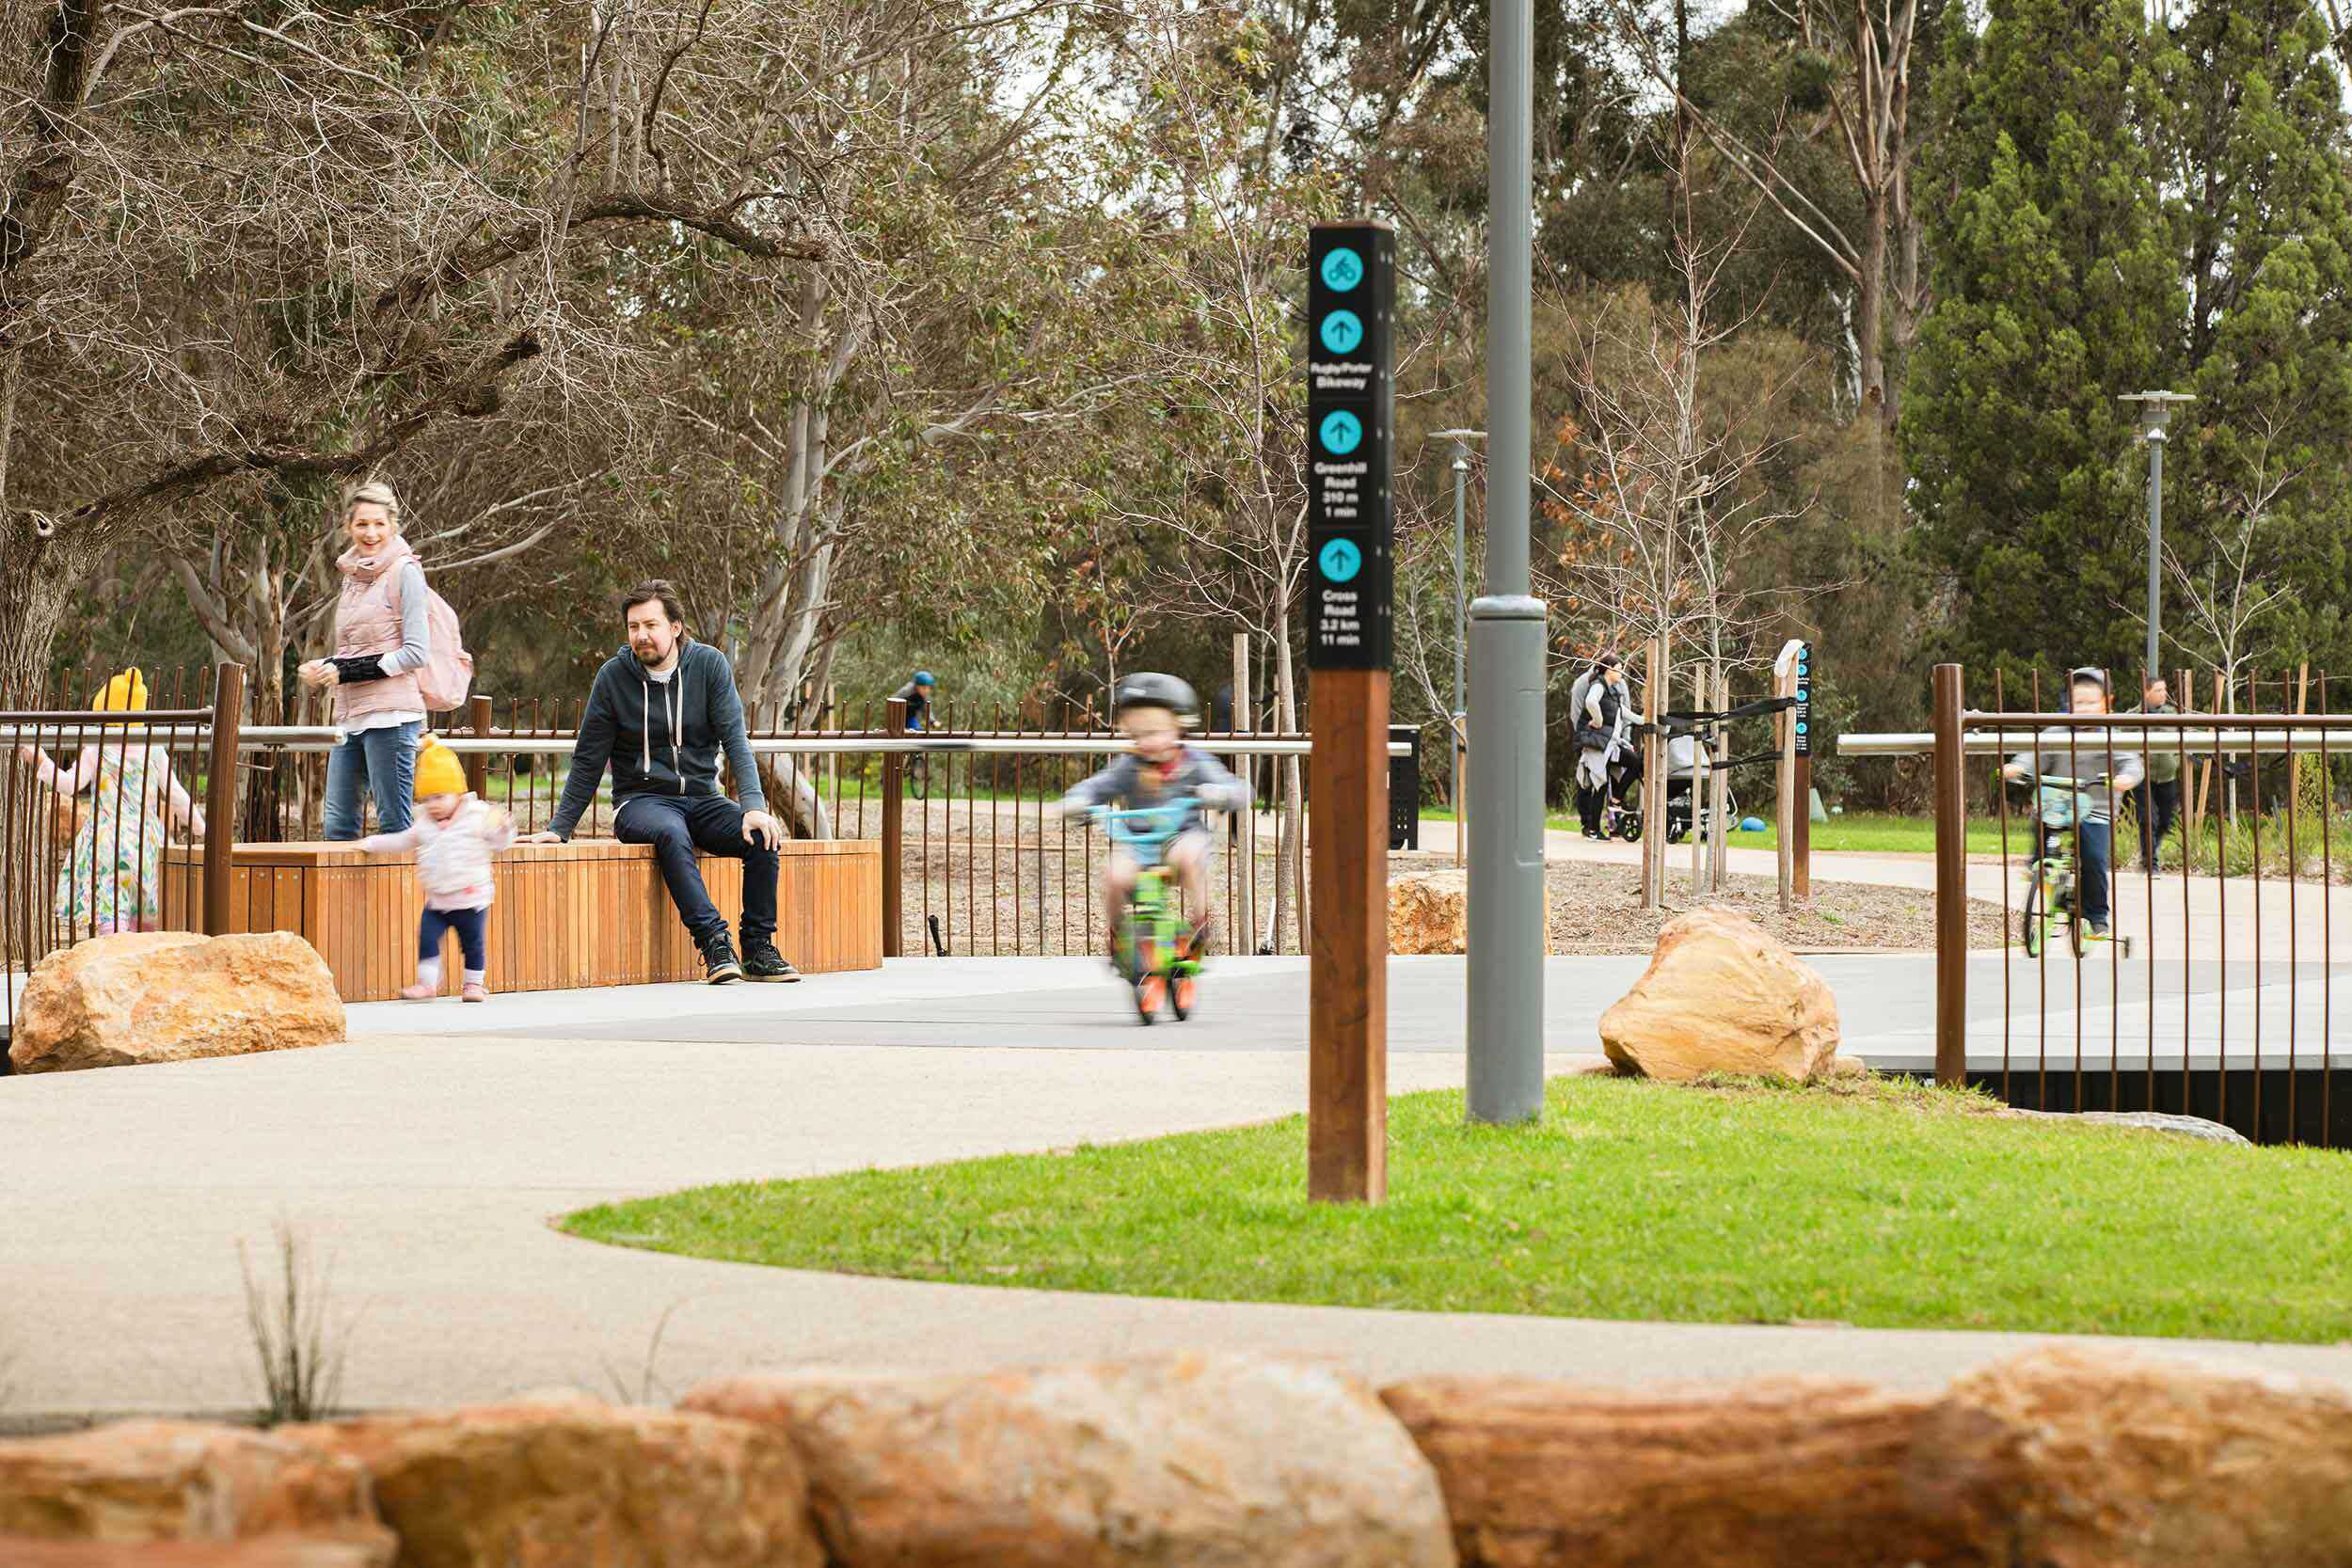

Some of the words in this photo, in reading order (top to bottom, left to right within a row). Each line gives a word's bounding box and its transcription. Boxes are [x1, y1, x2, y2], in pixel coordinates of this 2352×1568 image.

[1324, 476, 1357, 488] Road
[1325, 506, 1331, 517] 1
[1333, 506, 1357, 517] min
[1322, 590, 1357, 602] Cross
[1324, 604, 1357, 616] Road
[1340, 619, 1359, 629] km
[1321, 634, 1334, 645] 11
[1336, 634, 1359, 645] min
